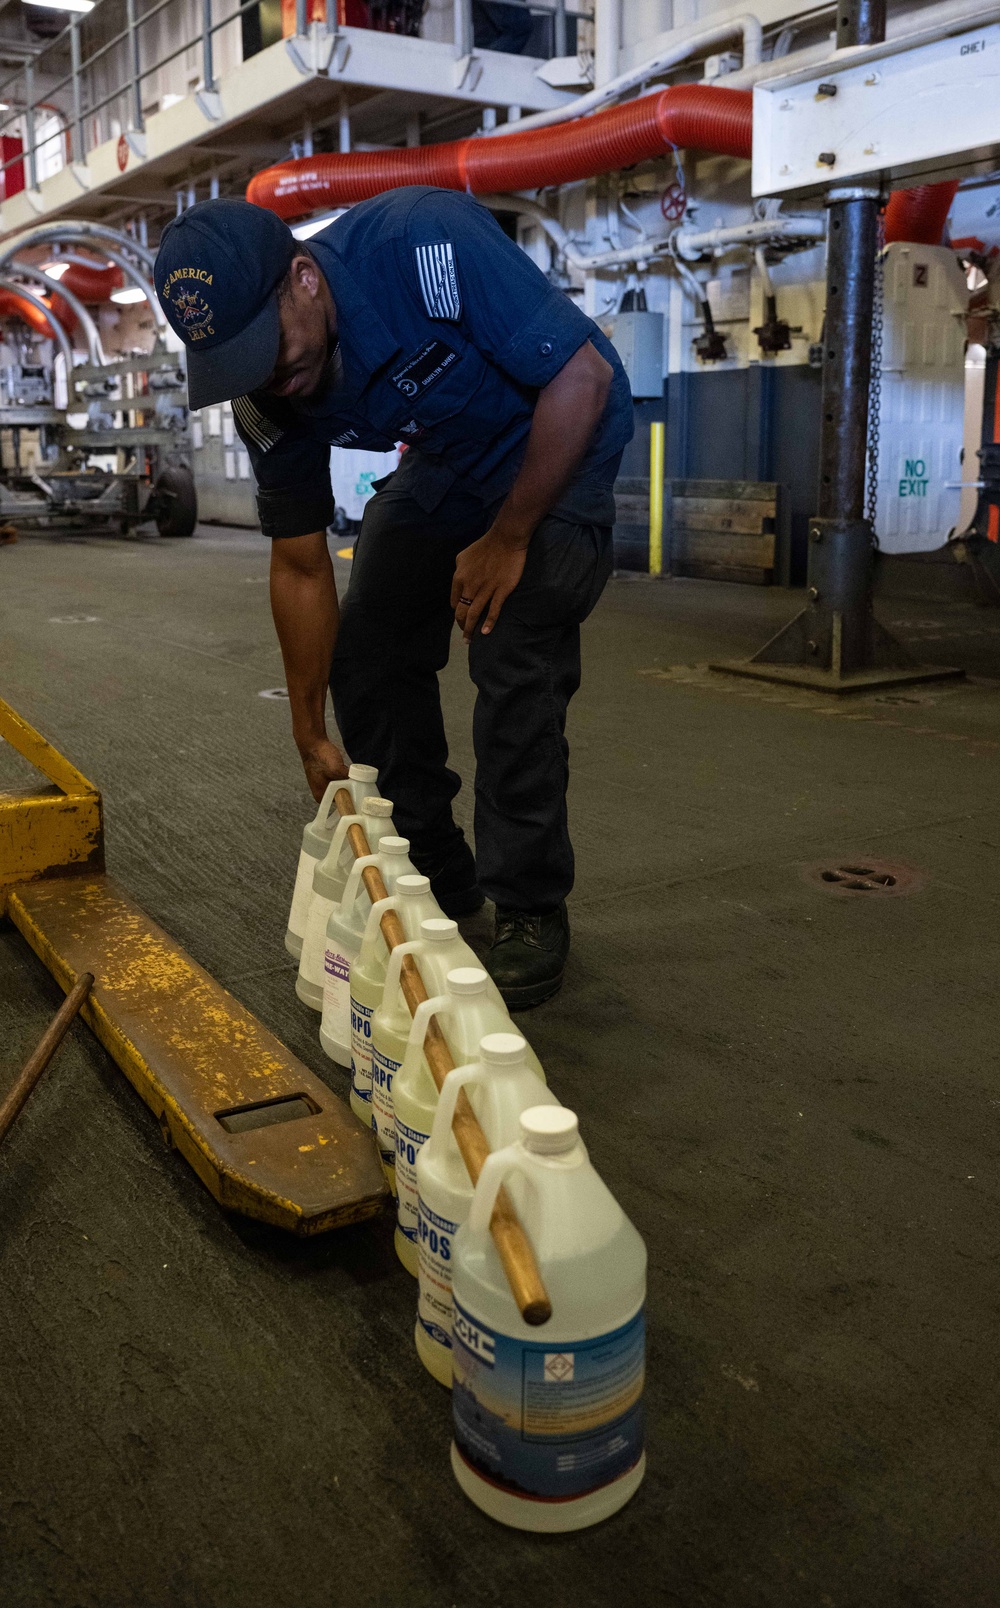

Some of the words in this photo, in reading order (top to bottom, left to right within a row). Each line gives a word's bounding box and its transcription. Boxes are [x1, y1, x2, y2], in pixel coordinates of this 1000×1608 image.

[169, 267, 213, 286] AMERICA
[188, 329, 207, 341] LHA
[207, 325, 215, 335] 6
[441, 352, 456, 367] DAVIS
[360, 471, 377, 482] NO
[905, 459, 926, 477] NO
[899, 479, 929, 497] EXIT
